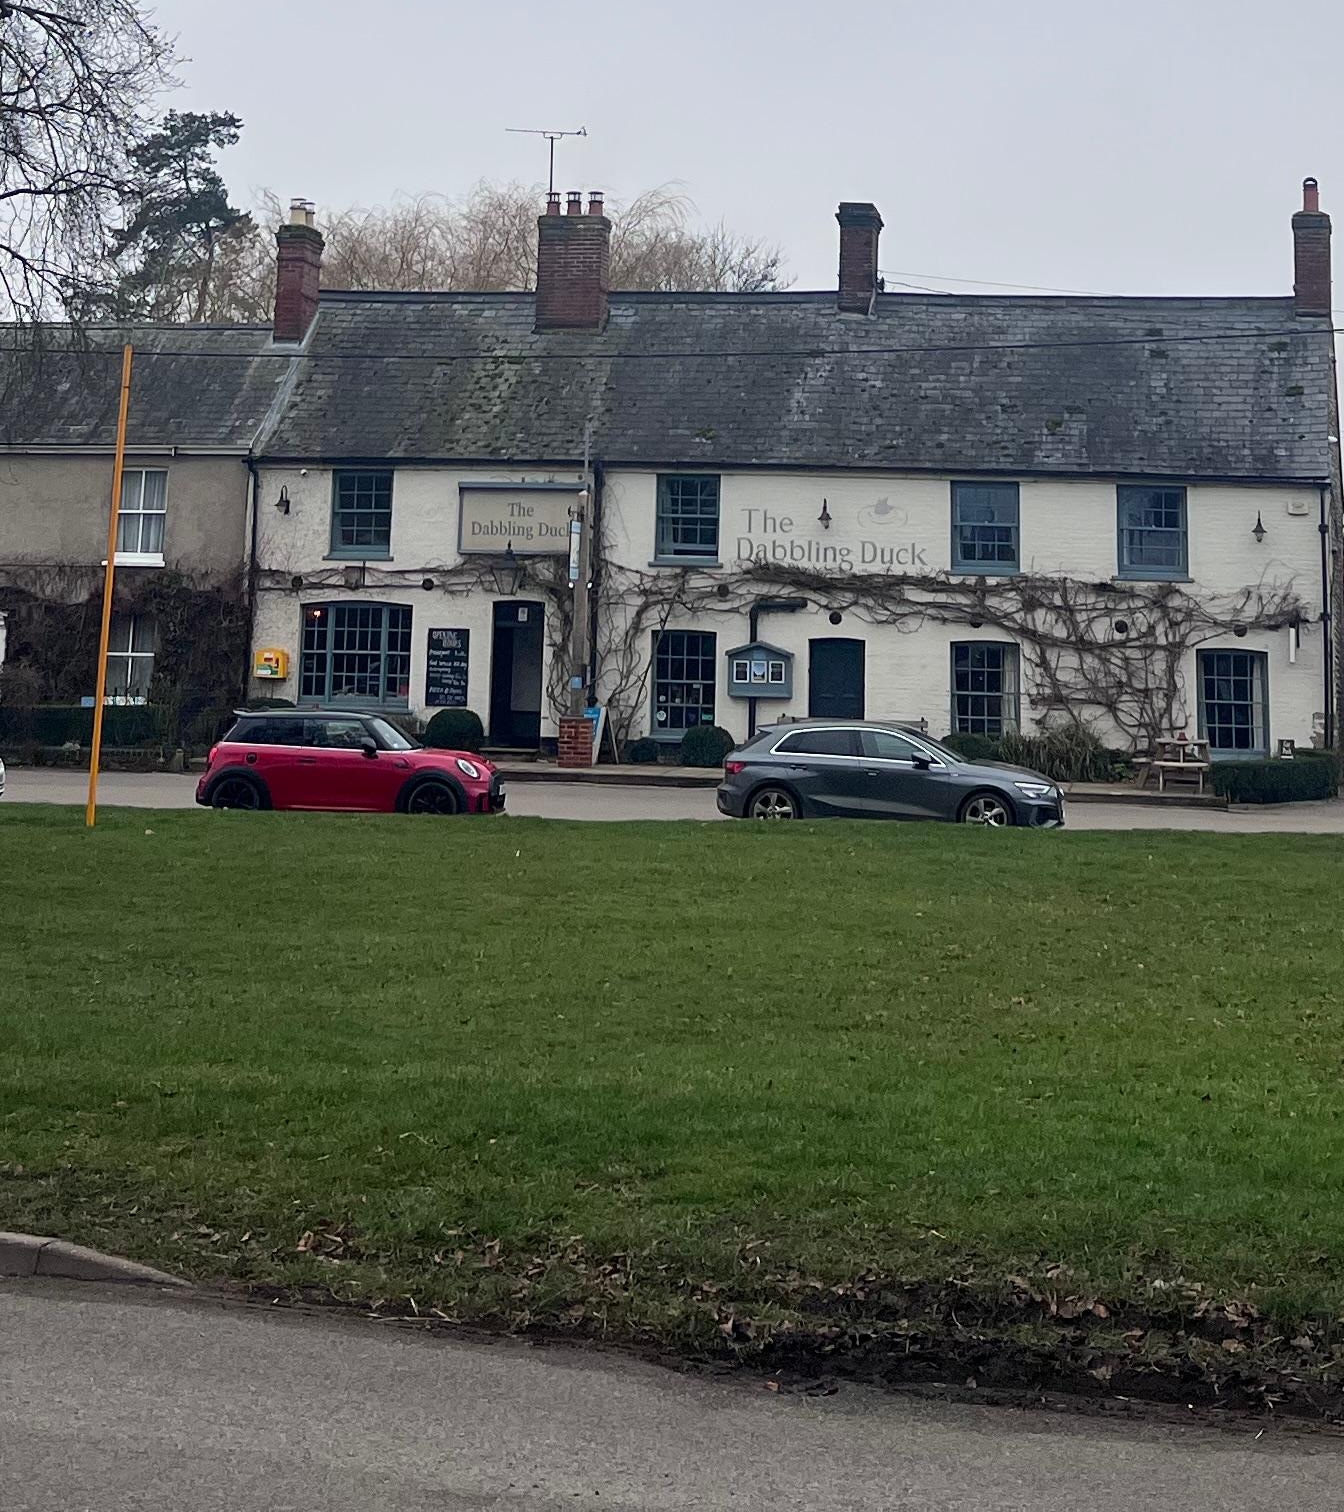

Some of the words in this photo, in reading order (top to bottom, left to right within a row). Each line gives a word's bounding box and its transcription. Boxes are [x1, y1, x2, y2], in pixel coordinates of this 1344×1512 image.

[508, 502, 534, 517] The
[471, 521, 533, 540] Dabbling
[741, 509, 794, 533] The
[736, 537, 853, 572] Dabbling
[860, 541, 928, 566] Duck
